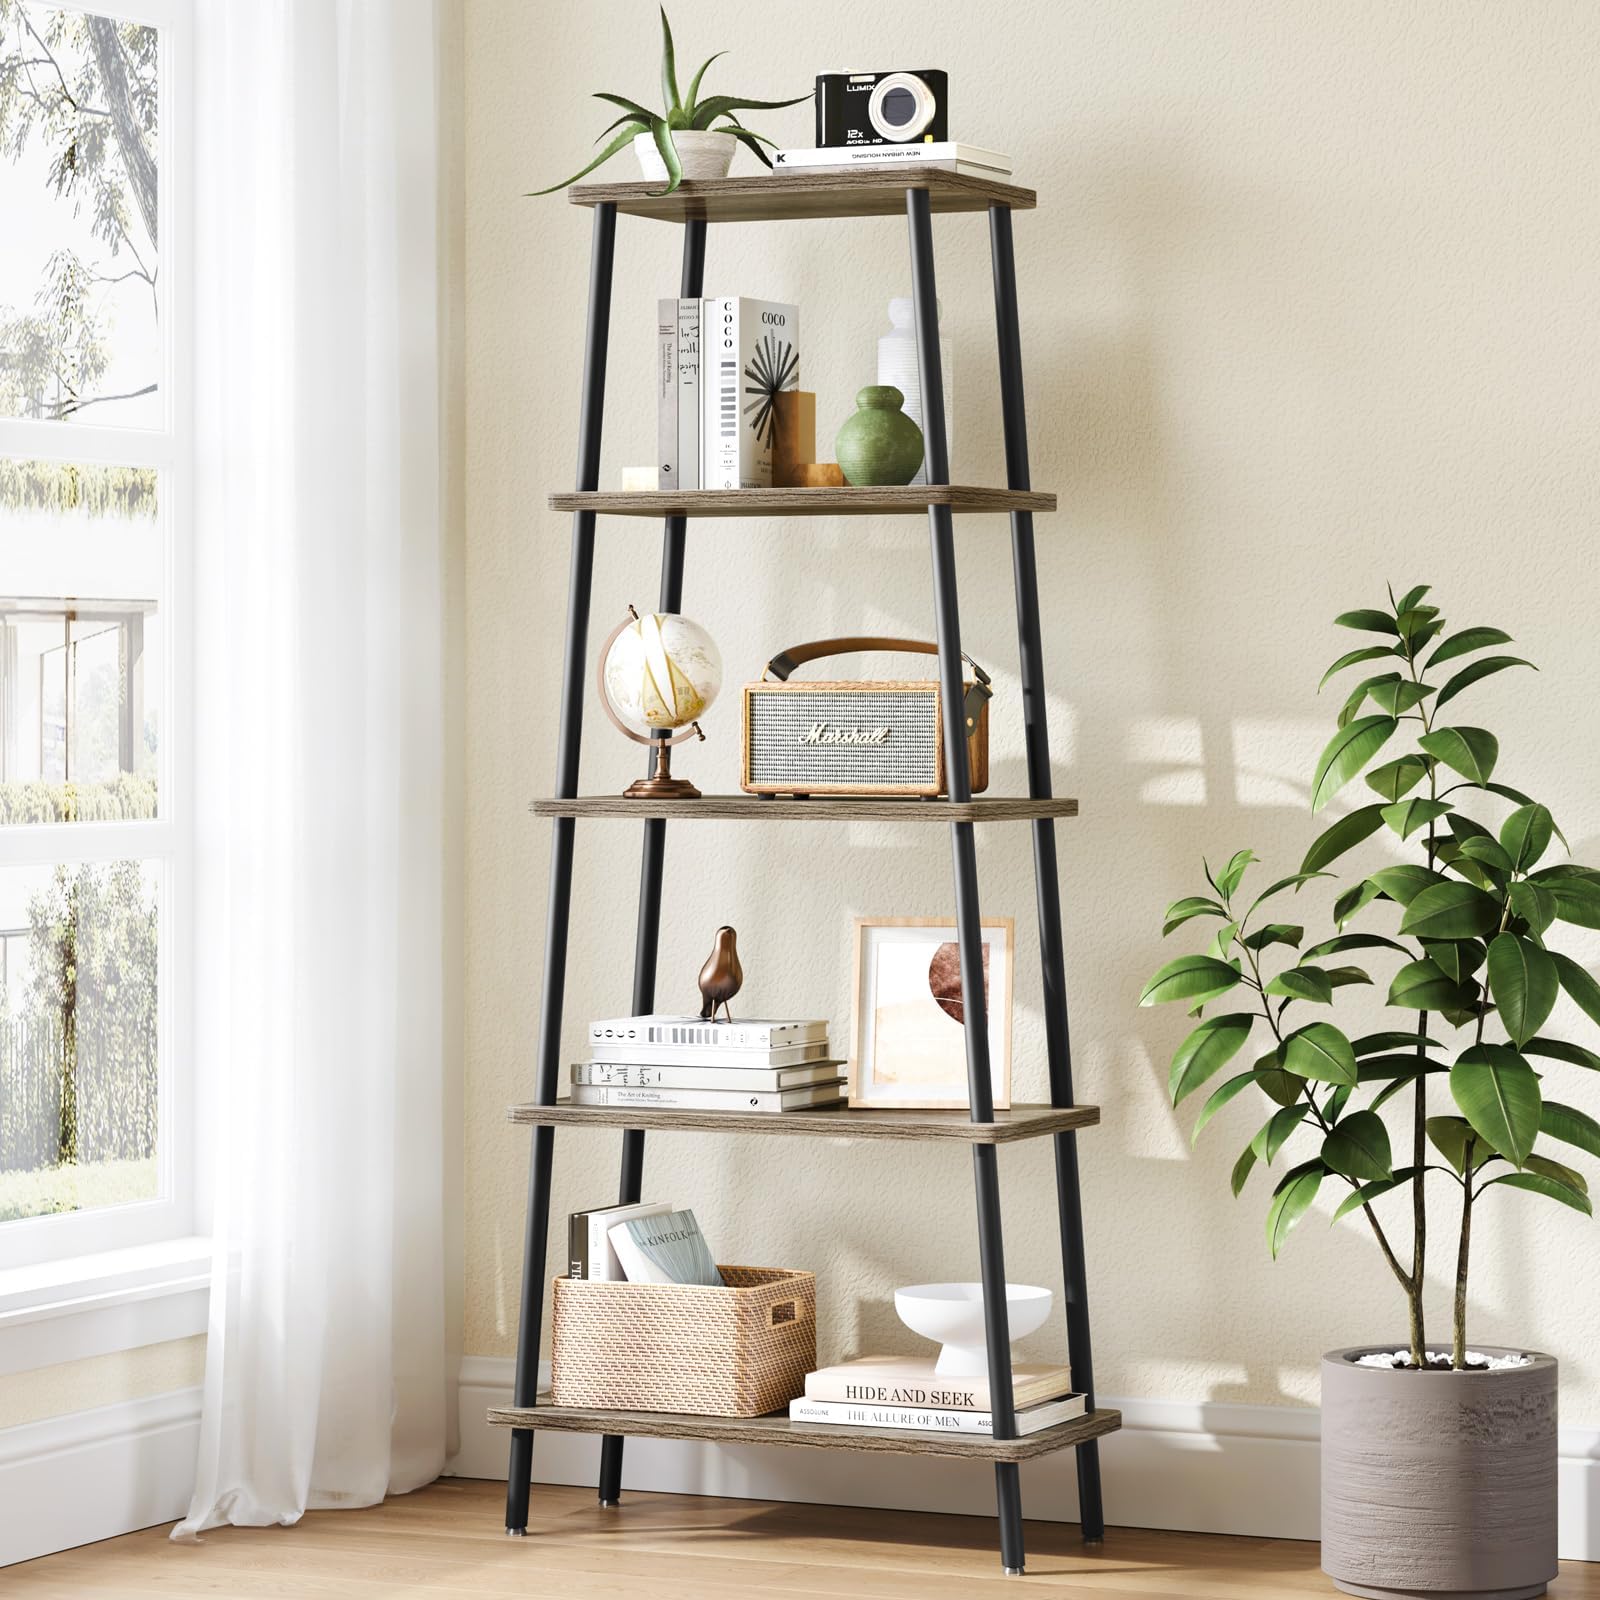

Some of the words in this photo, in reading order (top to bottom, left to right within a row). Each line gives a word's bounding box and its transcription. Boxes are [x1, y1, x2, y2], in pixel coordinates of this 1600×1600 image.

[846, 84, 875, 92] LUMIX
[847, 129, 864, 139] 12x
[776, 153, 787, 164] K
[761, 312, 785, 327] COCO
[798, 721, 890, 745] Marshall
[647, 1231, 688, 1247] KINFOLK
[846, 1384, 887, 1401] HIDE
[890, 1388, 926, 1404] AND
[930, 1391, 976, 1407] SEEK
[847, 1410, 865, 1421] THE
[870, 1411, 915, 1425] ALLURE
[917, 1414, 931, 1426] OF
[935, 1416, 961, 1427] MEN
